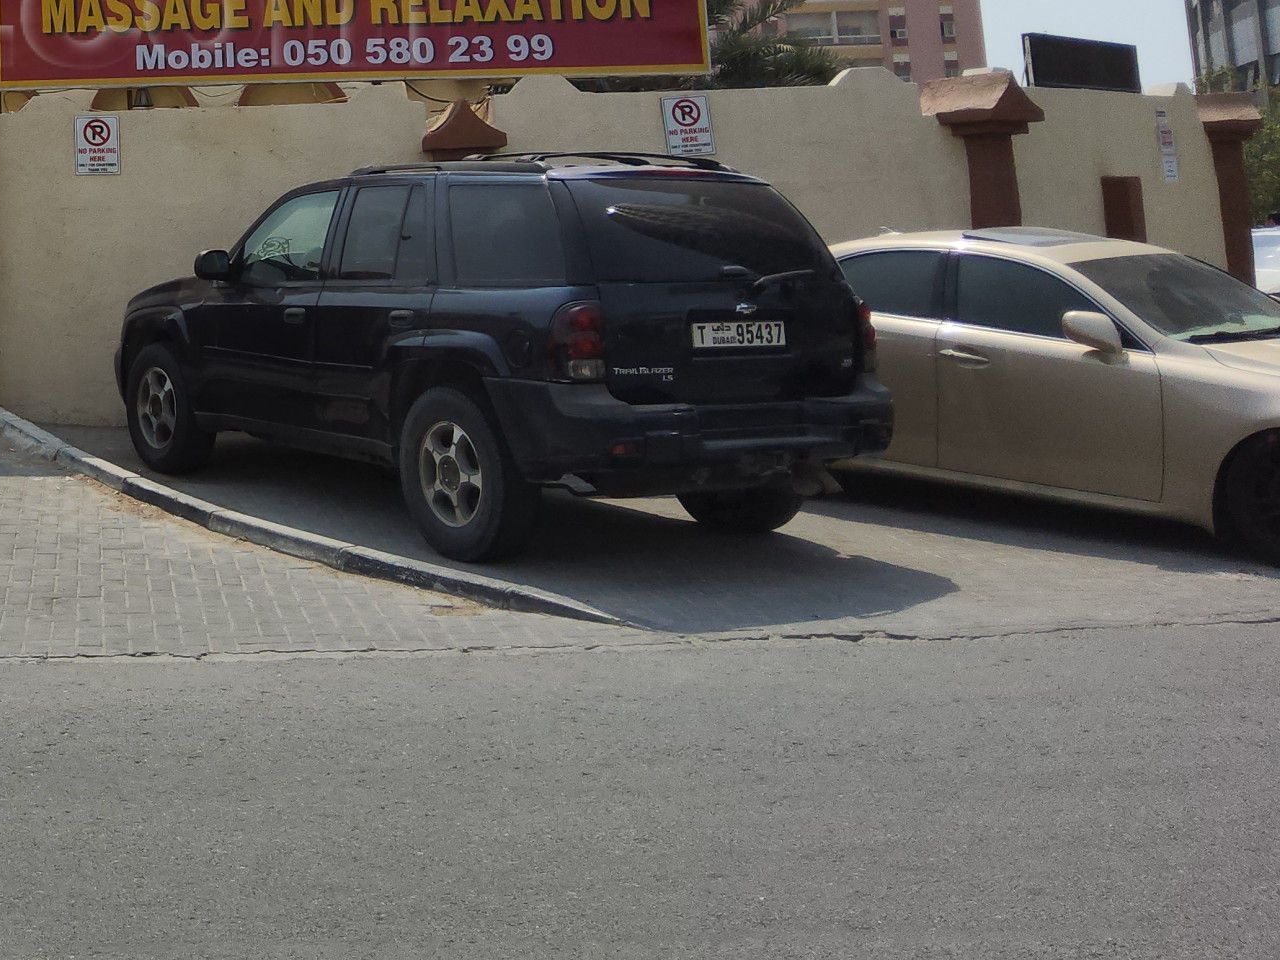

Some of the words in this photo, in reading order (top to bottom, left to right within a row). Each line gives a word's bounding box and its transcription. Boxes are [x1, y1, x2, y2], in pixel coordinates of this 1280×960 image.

[136, 41, 271, 71] Mobile:
[283, 38, 352, 66] 050
[365, 36, 434, 65] 580
[447, 35, 494, 62] 23
[506, 34, 554, 61] 99
[680, 127, 709, 135] PARKING
[697, 325, 706, 345] T
[736, 323, 783, 345] 95437
